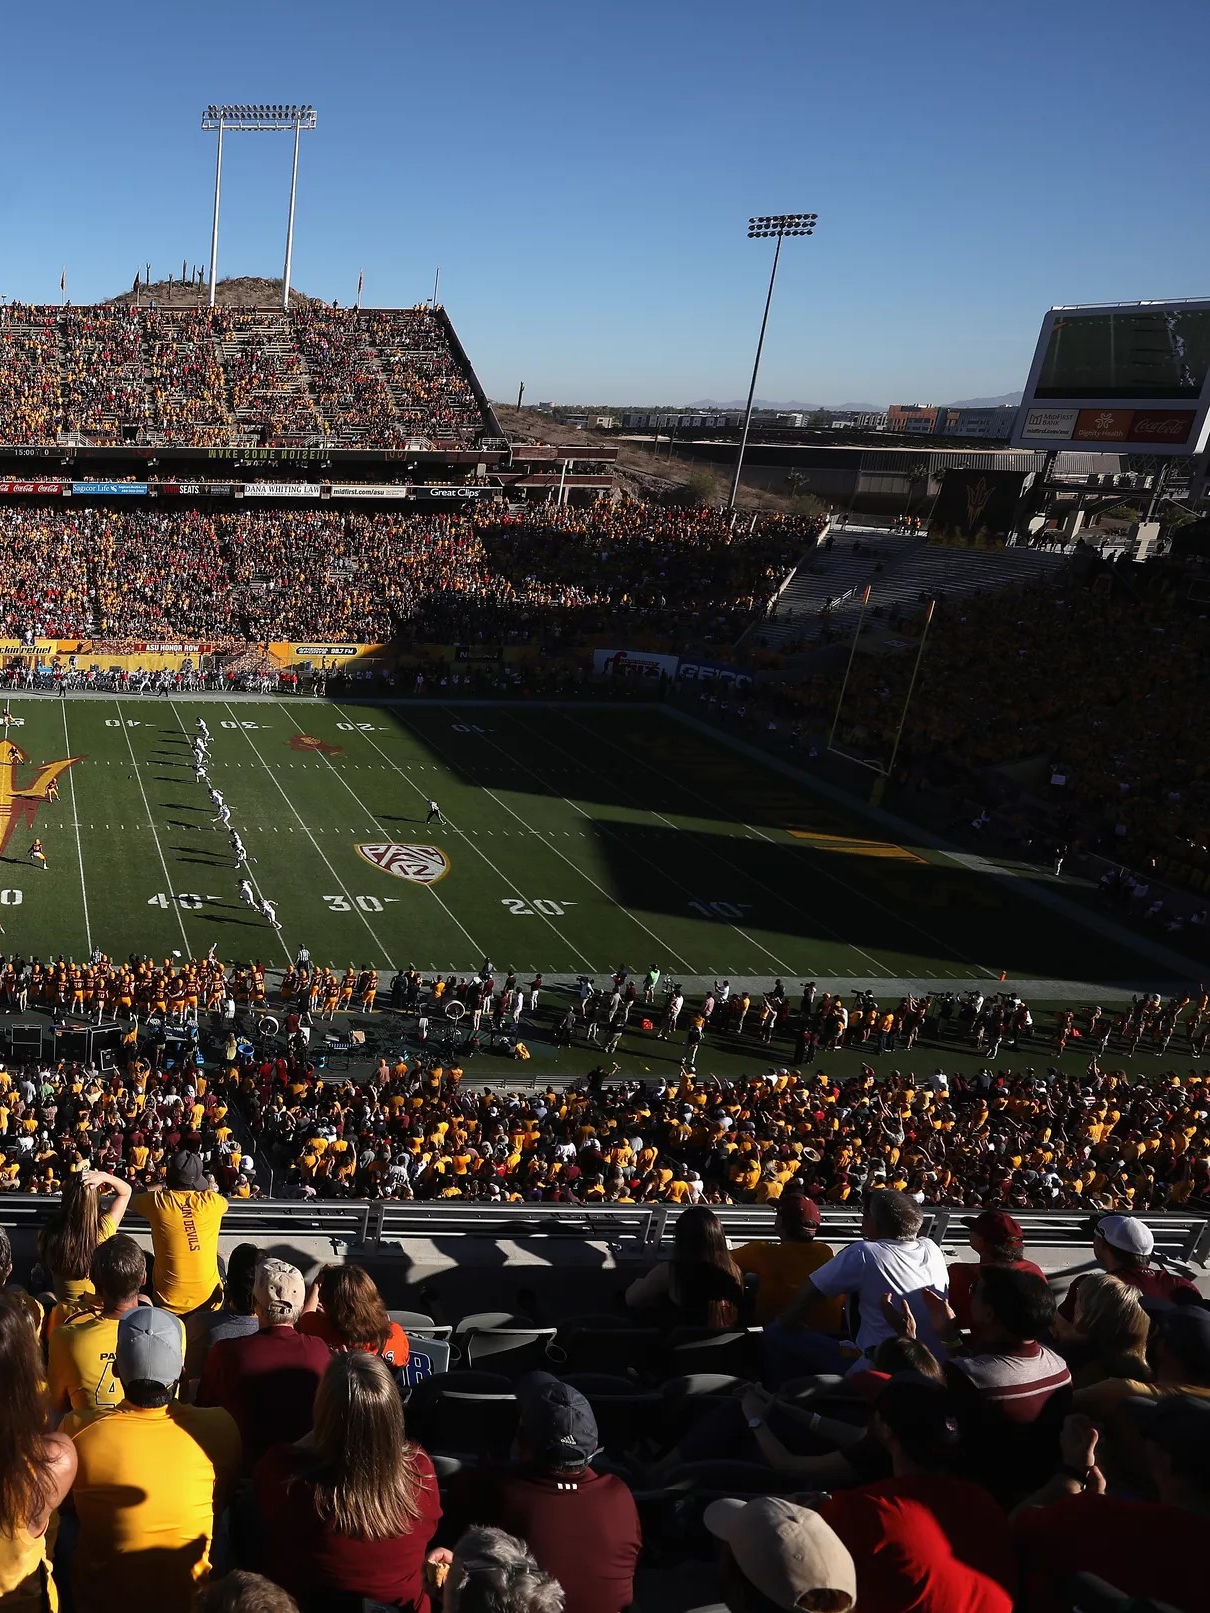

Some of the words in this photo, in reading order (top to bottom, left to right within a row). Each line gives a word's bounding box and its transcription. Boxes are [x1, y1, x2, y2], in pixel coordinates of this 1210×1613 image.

[1134, 419, 1187, 434] Coca-Cola
[1078, 429, 1101, 438] Dignity
[73, 484, 96, 493] Sagicor
[97, 484, 109, 492] Life
[180, 485, 199, 494] SEATS
[245, 485, 266, 493] DANA
[268, 485, 301, 493] WHITING
[304, 485, 319, 493] LAW
[333, 487, 384, 496] midfirst.com/asu
[430, 488, 455, 497] Great
[457, 488, 479, 498] Clips
[20, 645, 51, 654] refuel
[147, 892, 204, 910] 40
[322, 895, 384, 913] 30
[500, 897, 565, 916] 20
[687, 901, 744, 920] 10
[183, 1220, 200, 1251] DEVILS
